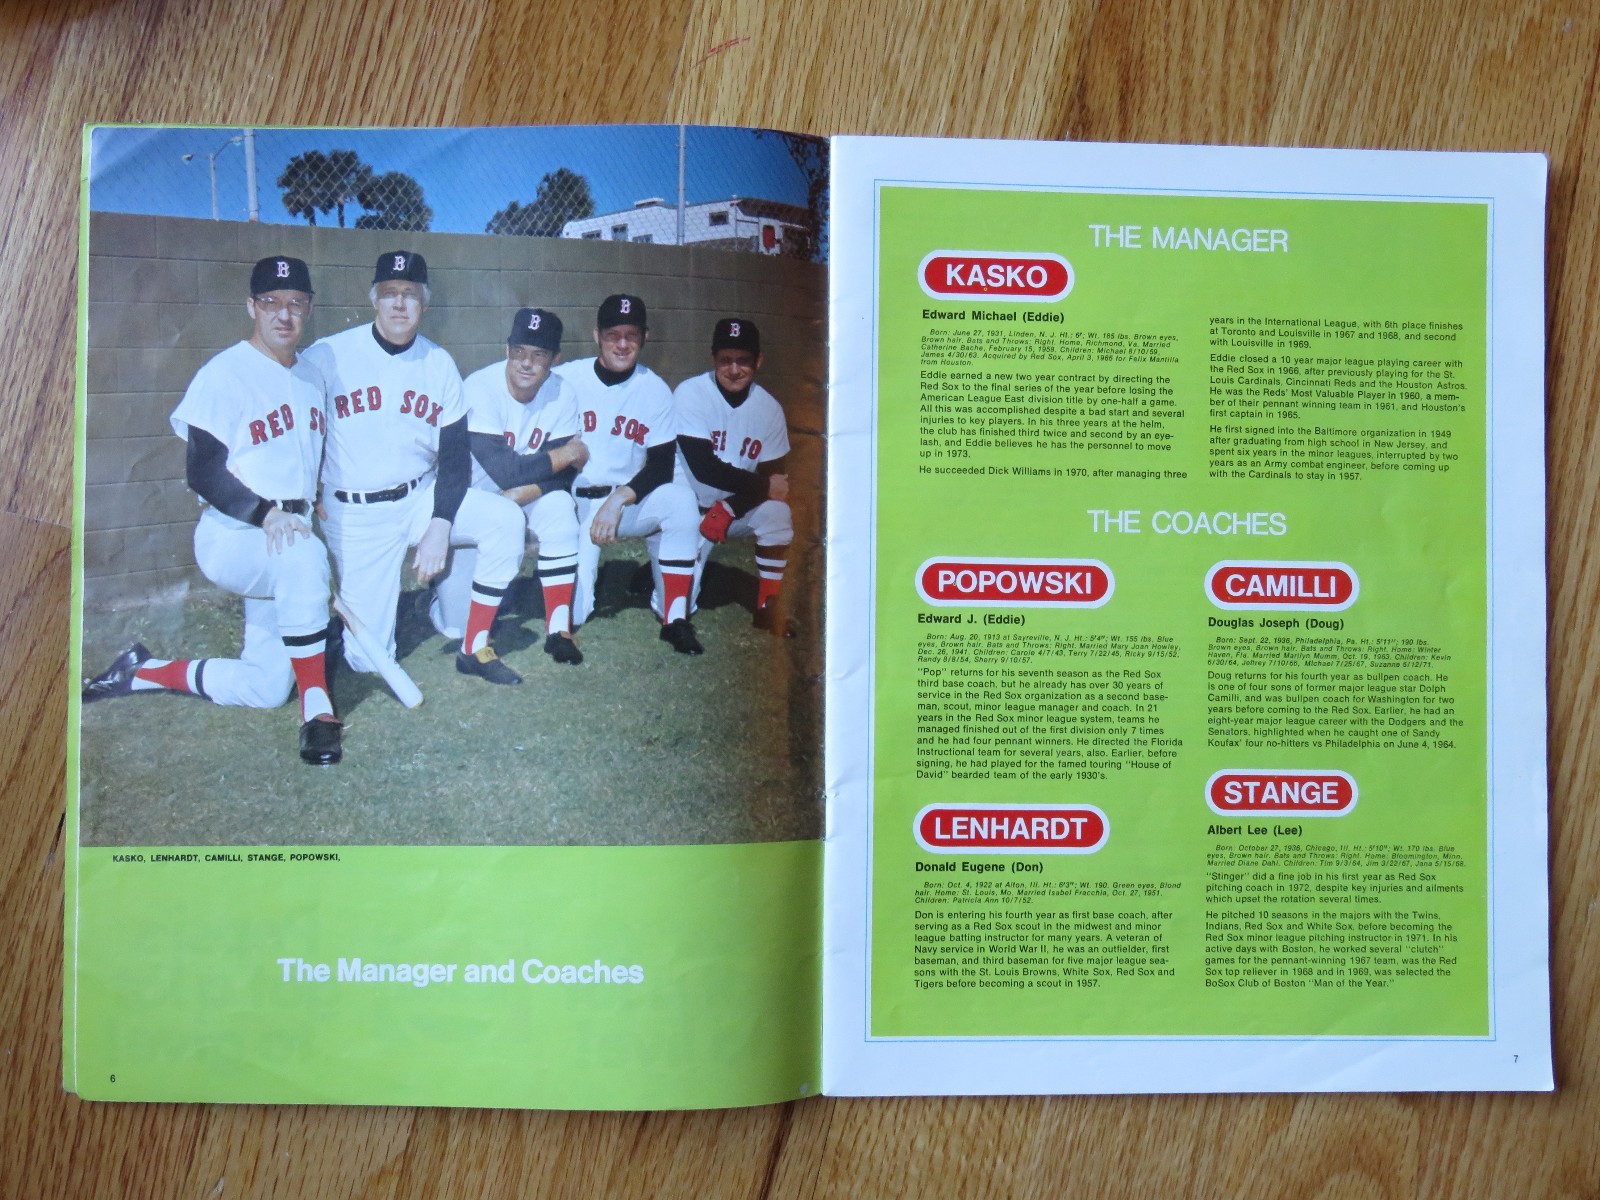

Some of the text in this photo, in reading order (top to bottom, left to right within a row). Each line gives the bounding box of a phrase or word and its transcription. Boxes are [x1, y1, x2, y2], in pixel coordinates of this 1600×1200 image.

[1088, 224, 1288, 252] THE MANAGER
[276, 261, 290, 278] B
[392, 256, 406, 271] B
[946, 264, 1048, 288] KASKO
[620, 299, 632, 314] B
[528, 314, 541, 330] B
[922, 310, 1065, 325] Edward Michael (Eddie)
[729, 322, 740, 337] B
[1209, 338, 1312, 349] with Louisville in 1969.
[920, 372, 948, 380] Eddie
[950, 372, 983, 381] earned
[1015, 374, 1033, 382] two
[1035, 375, 1056, 384] year
[1057, 374, 1096, 383] contract
[1098, 375, 1110, 385] by
[1113, 375, 1153, 386] directing
[1156, 376, 1171, 384] the
[334, 386, 443, 427] RED SOX
[1209, 410, 1301, 421] first captain in 1965.
[250, 404, 294, 445] RED
[610, 415, 650, 445] SOX
[919, 450, 971, 460] up in 1973.
[919, 466, 1188, 480] He succeeded Dick Williams in 1970, after managing three
[1209, 470, 1362, 482] with the Cardinals to stay in 1957.
[1087, 510, 1287, 536] THE COACHES
[938, 570, 1092, 594] POPOWSKI
[1225, 574, 1336, 598] CAMILLI
[918, 614, 1026, 628] Edward J. (Eddie)
[1208, 618, 1344, 632] Douglas Joseph (Doug)
[950, 668, 984, 677] returns
[986, 669, 1000, 678] for
[1001, 669, 1016, 678] his
[1018, 669, 1054, 678] seventh
[1105, 670, 1120, 678] the
[1123, 670, 1141, 679] Red
[1144, 670, 1162, 679] Sox
[1207, 694, 1242, 705] Camilli,
[1244, 695, 1262, 703] and
[1286, 695, 1320, 705] bullpen
[1322, 695, 1350, 704] coach
[1352, 696, 1366, 704] for
[1367, 696, 1420, 706] Washington
[1422, 696, 1436, 704] for
[1438, 696, 1455, 705] two
[1245, 740, 1264, 748] four
[1266, 740, 1310, 748] no-hitters
[1325, 740, 1381, 751] Philadelphia
[1396, 741, 1420, 749] June
[1421, 741, 1430, 751] 4,
[1432, 741, 1456, 749] 1964.
[951, 772, 990, 780] bearded
[993, 772, 1017, 780] team
[1019, 772, 1029, 780] of
[1032, 772, 1047, 780] the
[1049, 772, 1073, 782] early
[1224, 781, 1338, 804] STANGE
[934, 817, 1088, 840] LENHARDT
[1207, 826, 1303, 838] Albert Lee (Lee)
[112, 854, 340, 863] KASKO, LENHARDT, CAMILLI, STANGE, POPOWSKI,
[916, 862, 1044, 875] Donald Eugene (Don)
[1205, 895, 1382, 906] which upset the rotation several times.
[277, 958, 644, 988] The Manager and Coaches
[914, 980, 944, 990] Tigers
[946, 980, 977, 988] before
[979, 980, 1025, 990] becoming
[1036, 980, 1062, 988] scout
[1064, 980, 1073, 988] in
[1076, 980, 1101, 988] 1957.
[1205, 979, 1236, 988] BoSox
[1238, 979, 1260, 988] Club
[1262, 979, 1271, 988] of
[1274, 979, 1306, 988] Boston
[1336, 979, 1345, 988] of
[1348, 979, 1363, 988] the
[1513, 1054, 1518, 1063] 7
[110, 1074, 116, 1082] 6
